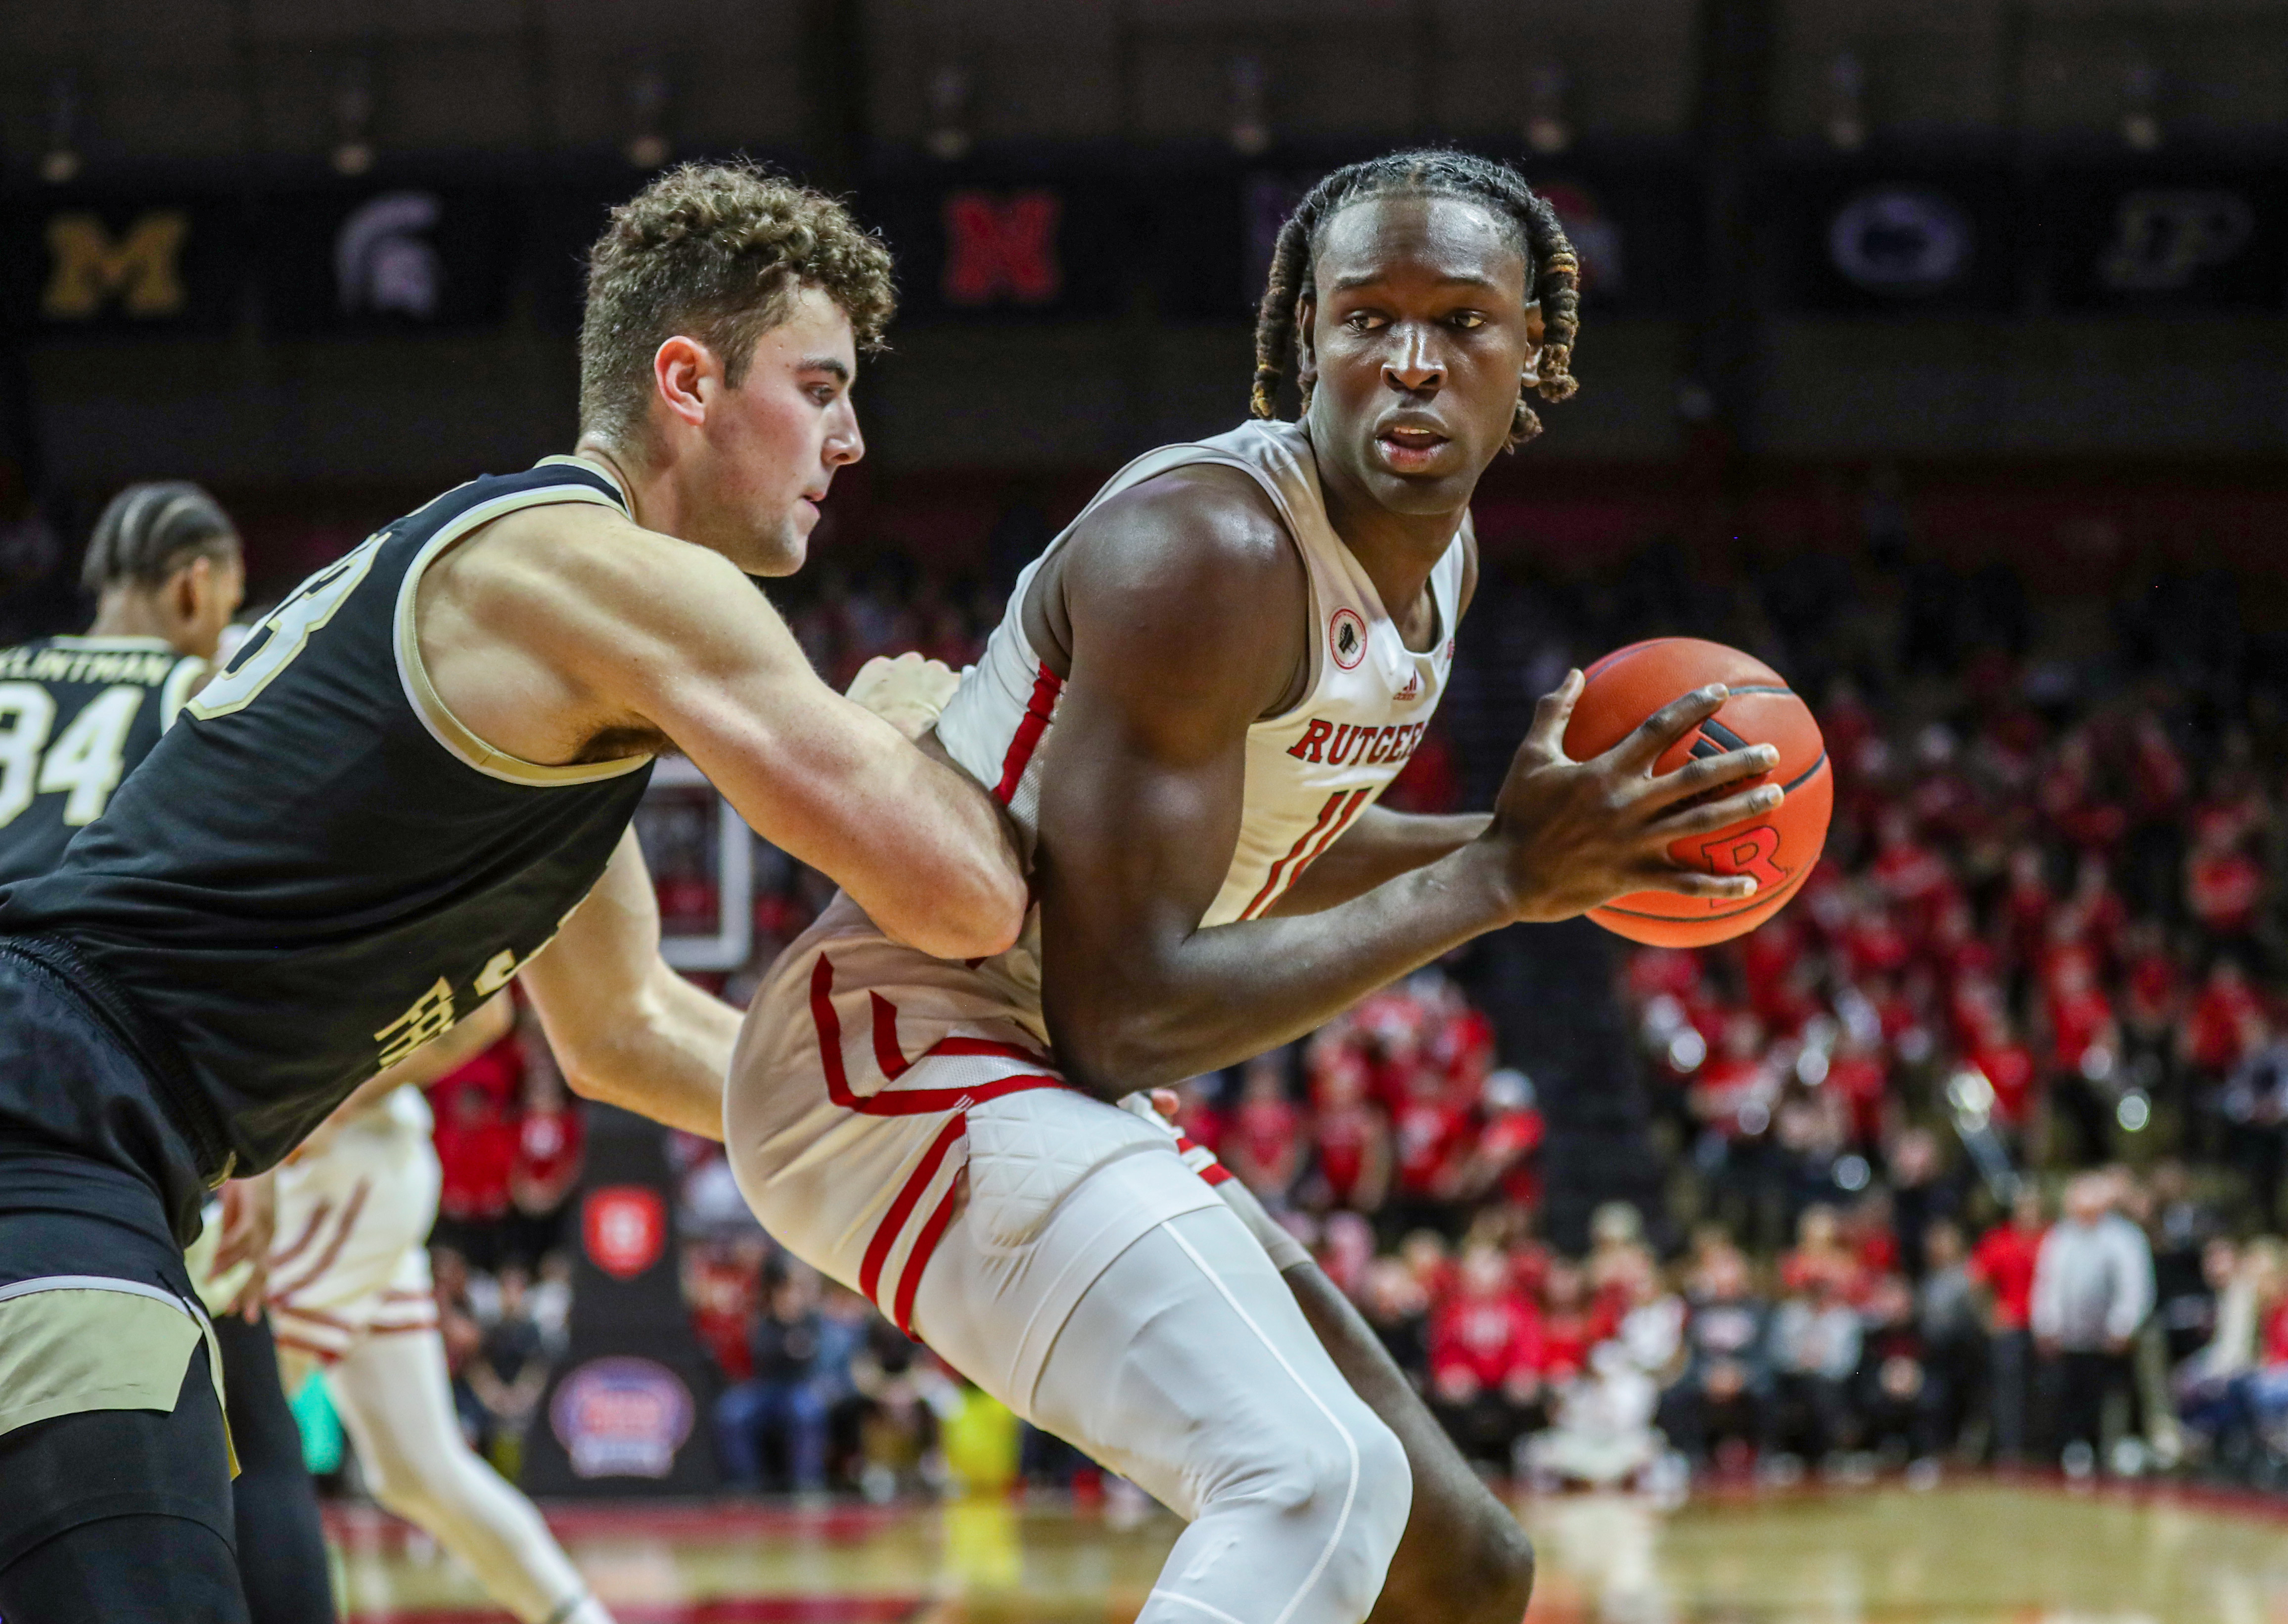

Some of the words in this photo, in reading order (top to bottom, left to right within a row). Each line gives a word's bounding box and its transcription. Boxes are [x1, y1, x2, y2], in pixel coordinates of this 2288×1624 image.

[45, 214, 187, 316] M
[1236, 786, 1373, 921] 11
[1701, 825, 1789, 908] R
